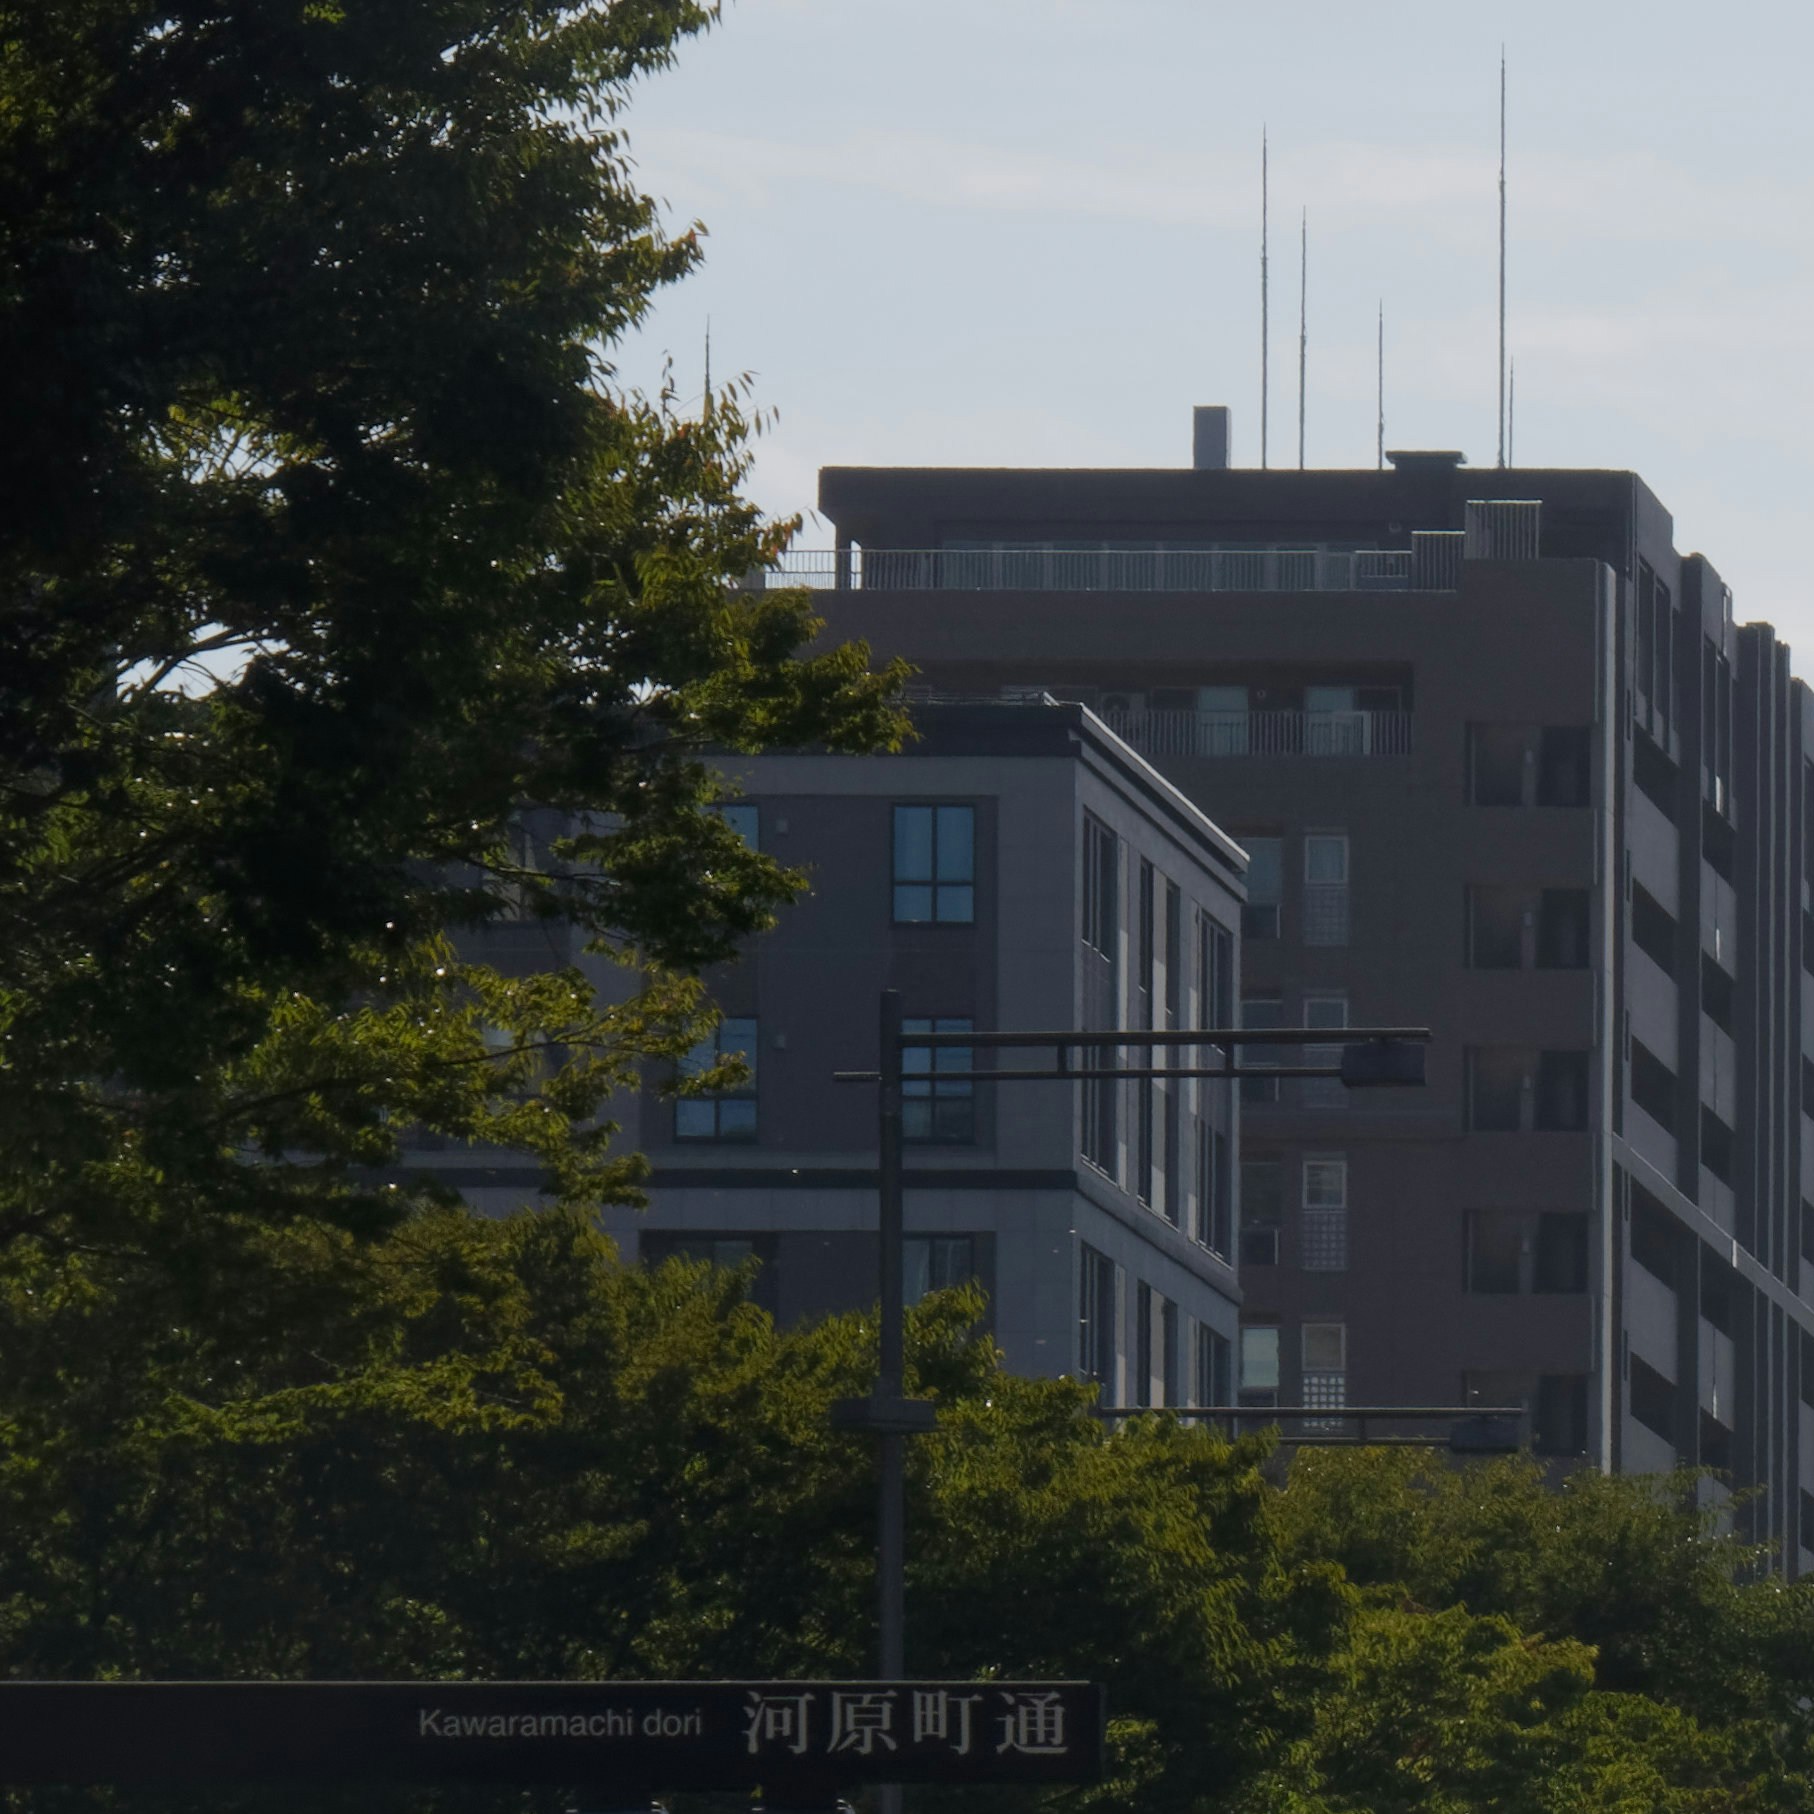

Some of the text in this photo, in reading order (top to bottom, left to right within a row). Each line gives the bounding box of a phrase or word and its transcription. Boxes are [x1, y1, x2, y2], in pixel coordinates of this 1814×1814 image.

[418, 1708, 702, 1738] Kawaramachi dori
[741, 1690, 1070, 1756] 河原町通
